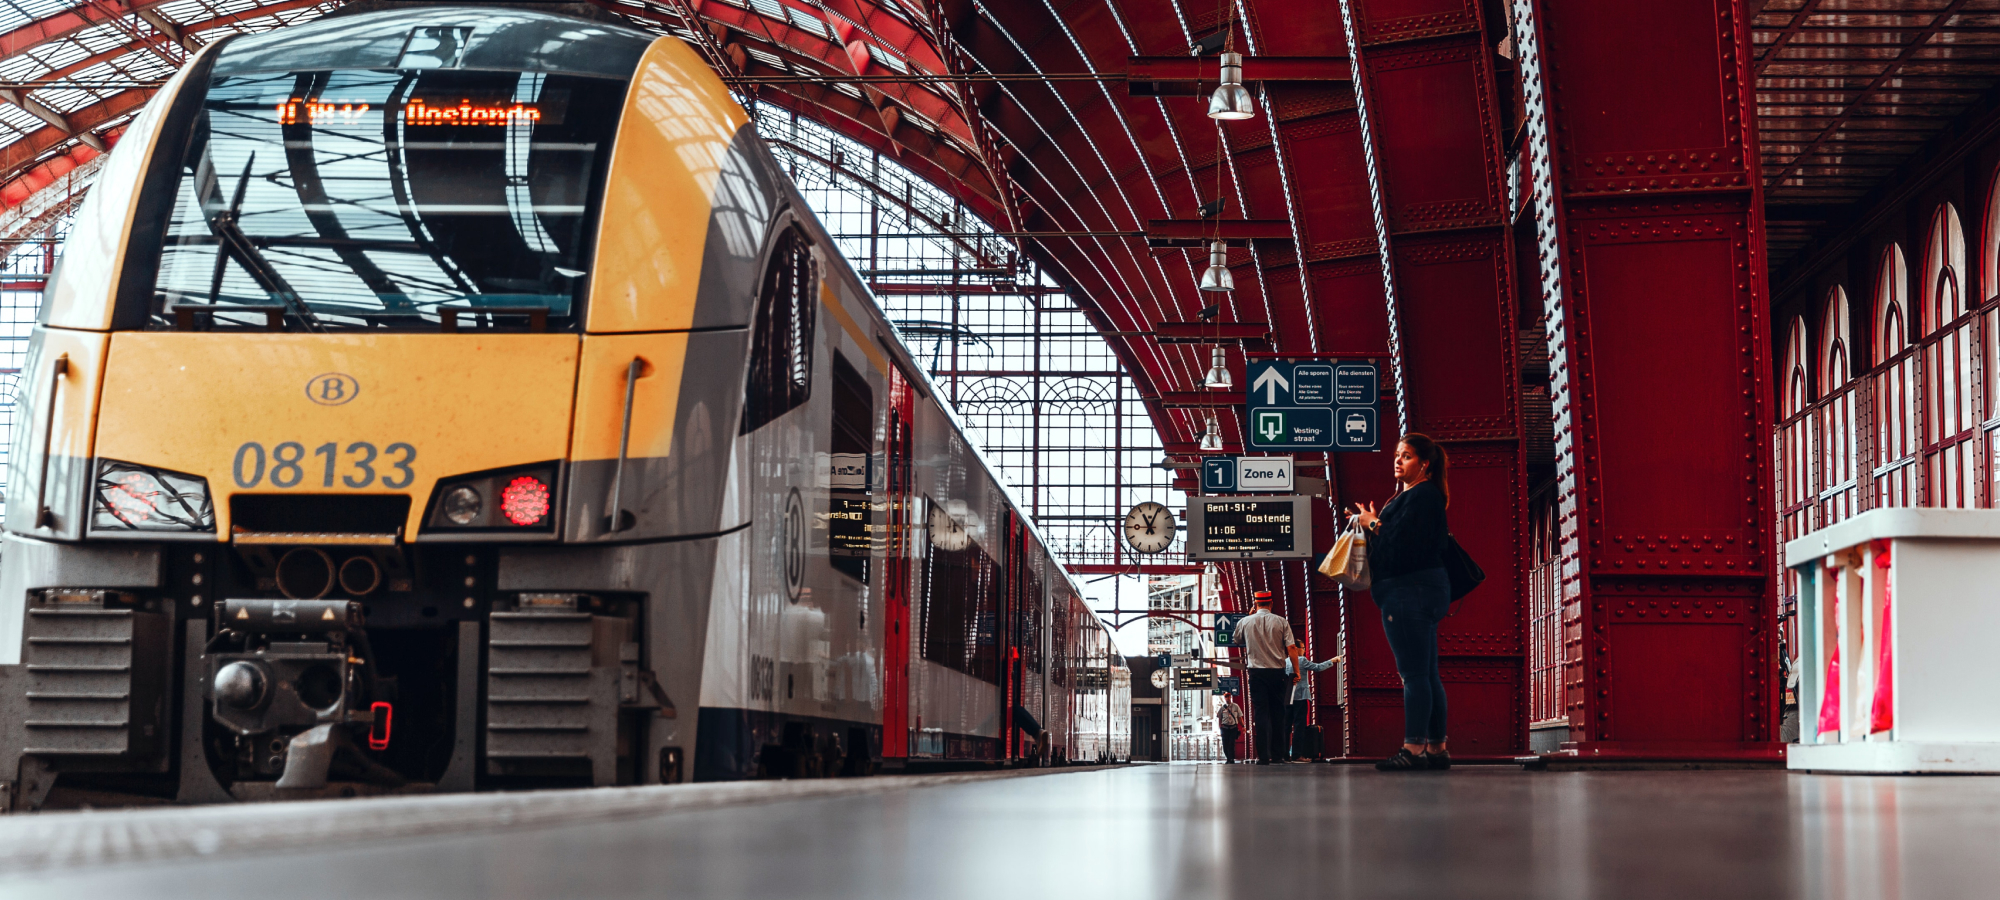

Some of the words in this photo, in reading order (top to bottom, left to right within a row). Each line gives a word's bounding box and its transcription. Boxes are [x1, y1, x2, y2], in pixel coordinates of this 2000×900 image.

[320, 377, 345, 401] B
[1294, 427, 1322, 436] Vesting-
[232, 441, 418, 490] 08133
[1214, 467, 1223, 485] 1
[1244, 468, 1274, 479] Zone
[1276, 468, 1286, 479] A
[1207, 503, 1257, 512] Gent-St-P
[1246, 514, 1291, 523] Oostende
[1208, 526, 1236, 535] 11:06
[1280, 525, 1291, 534] IC
